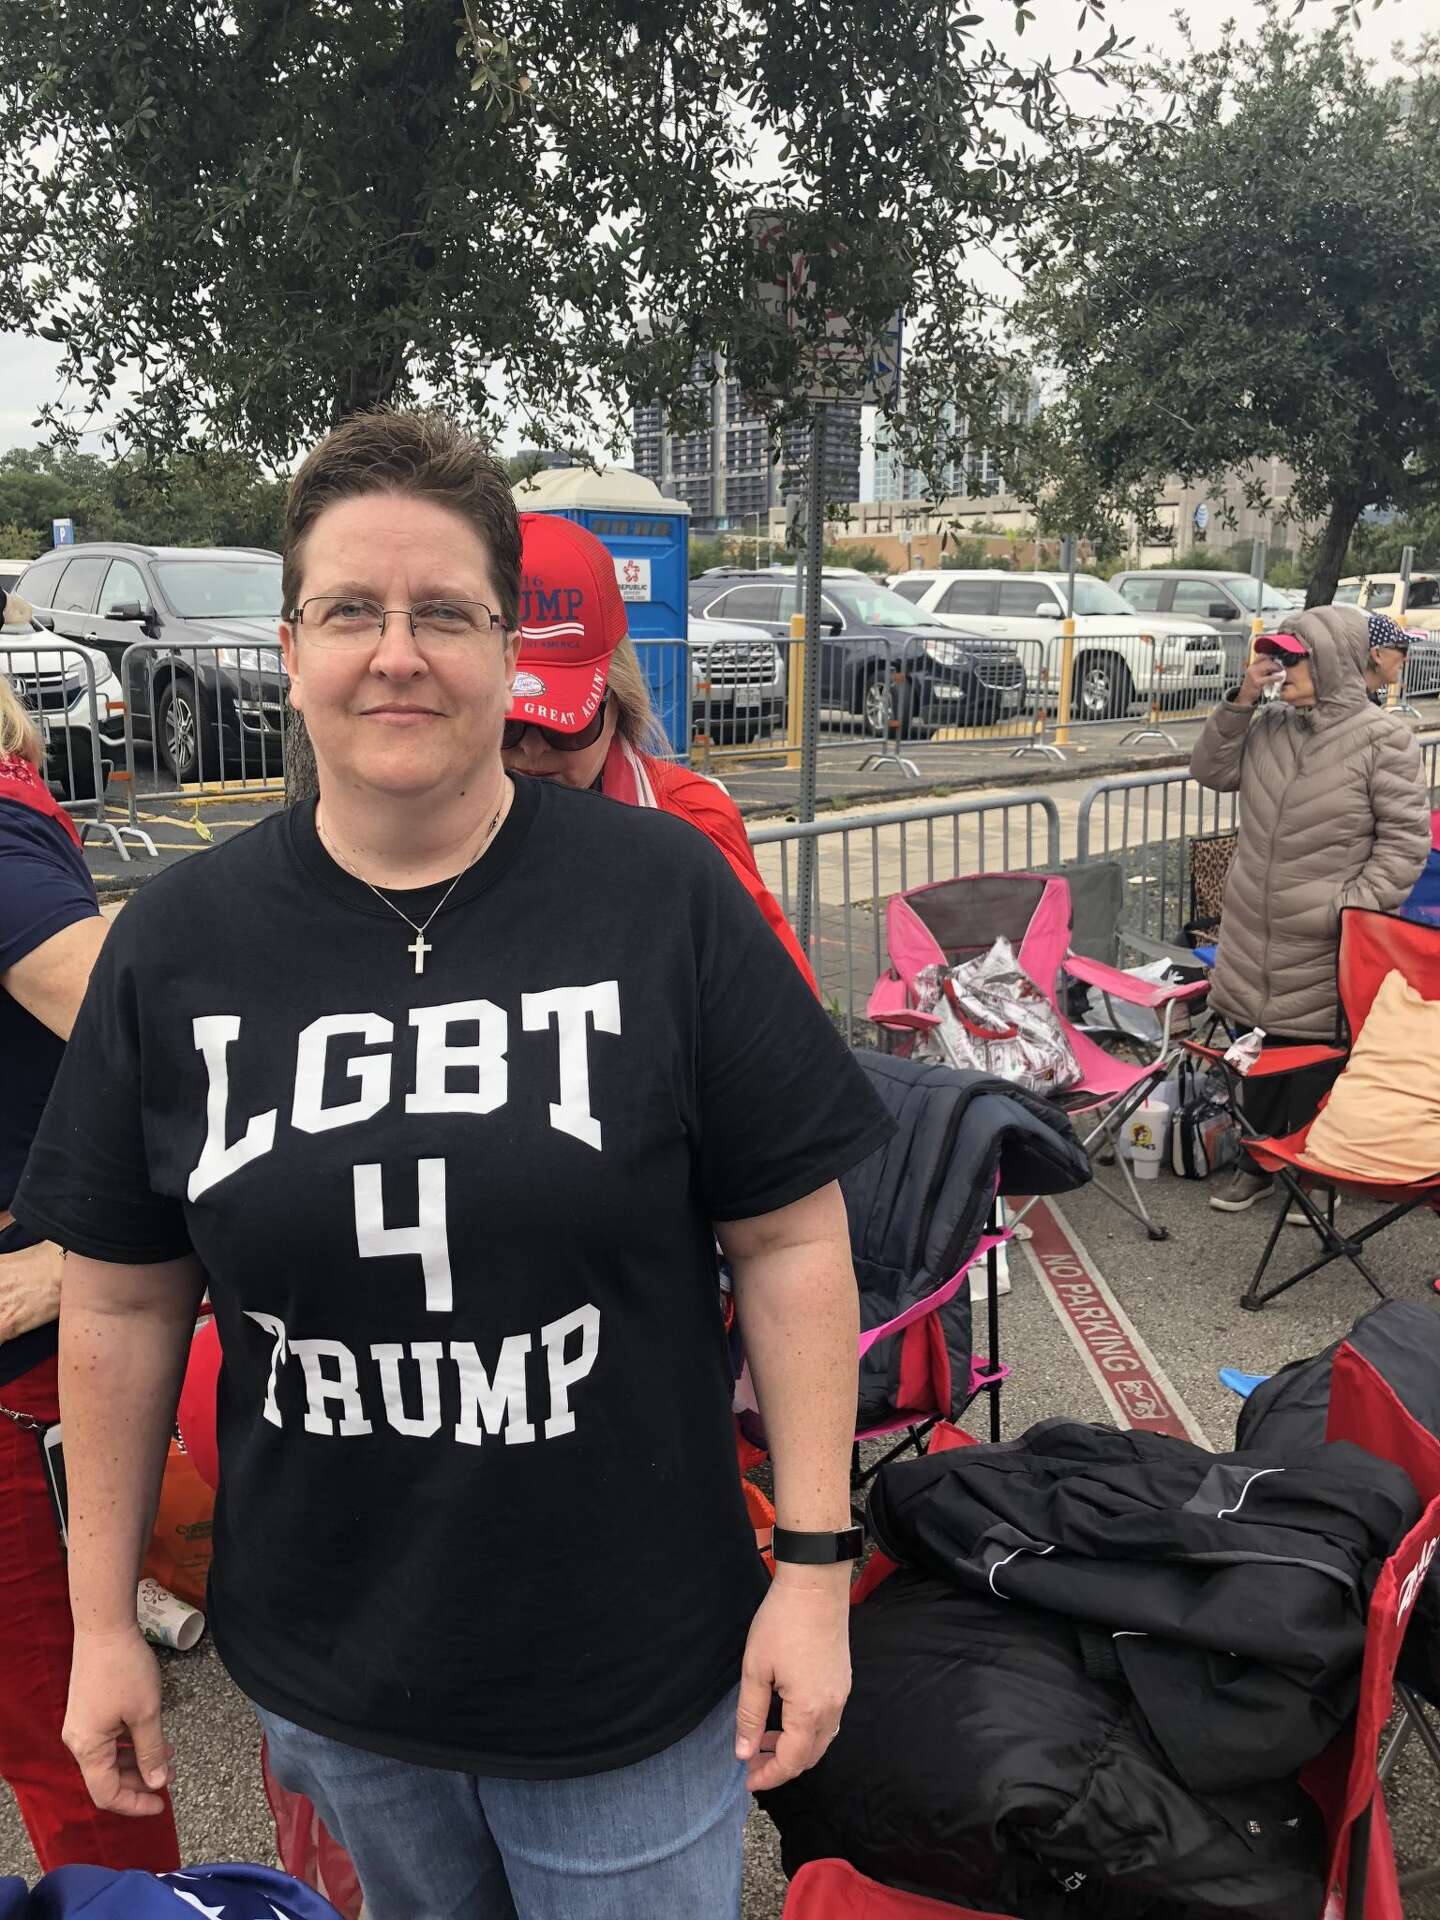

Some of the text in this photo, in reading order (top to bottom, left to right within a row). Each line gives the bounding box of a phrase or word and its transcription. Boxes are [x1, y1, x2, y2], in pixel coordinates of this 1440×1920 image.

[519, 588, 584, 621] UMP
[524, 702, 576, 725] GREAT
[581, 667, 606, 718] AGAIN!
[187, 981, 621, 1203] LGBT
[353, 1158, 453, 1312] 4
[242, 1303, 600, 1446] TRUMP
[1040, 1254, 1141, 1372] NO PARKING
